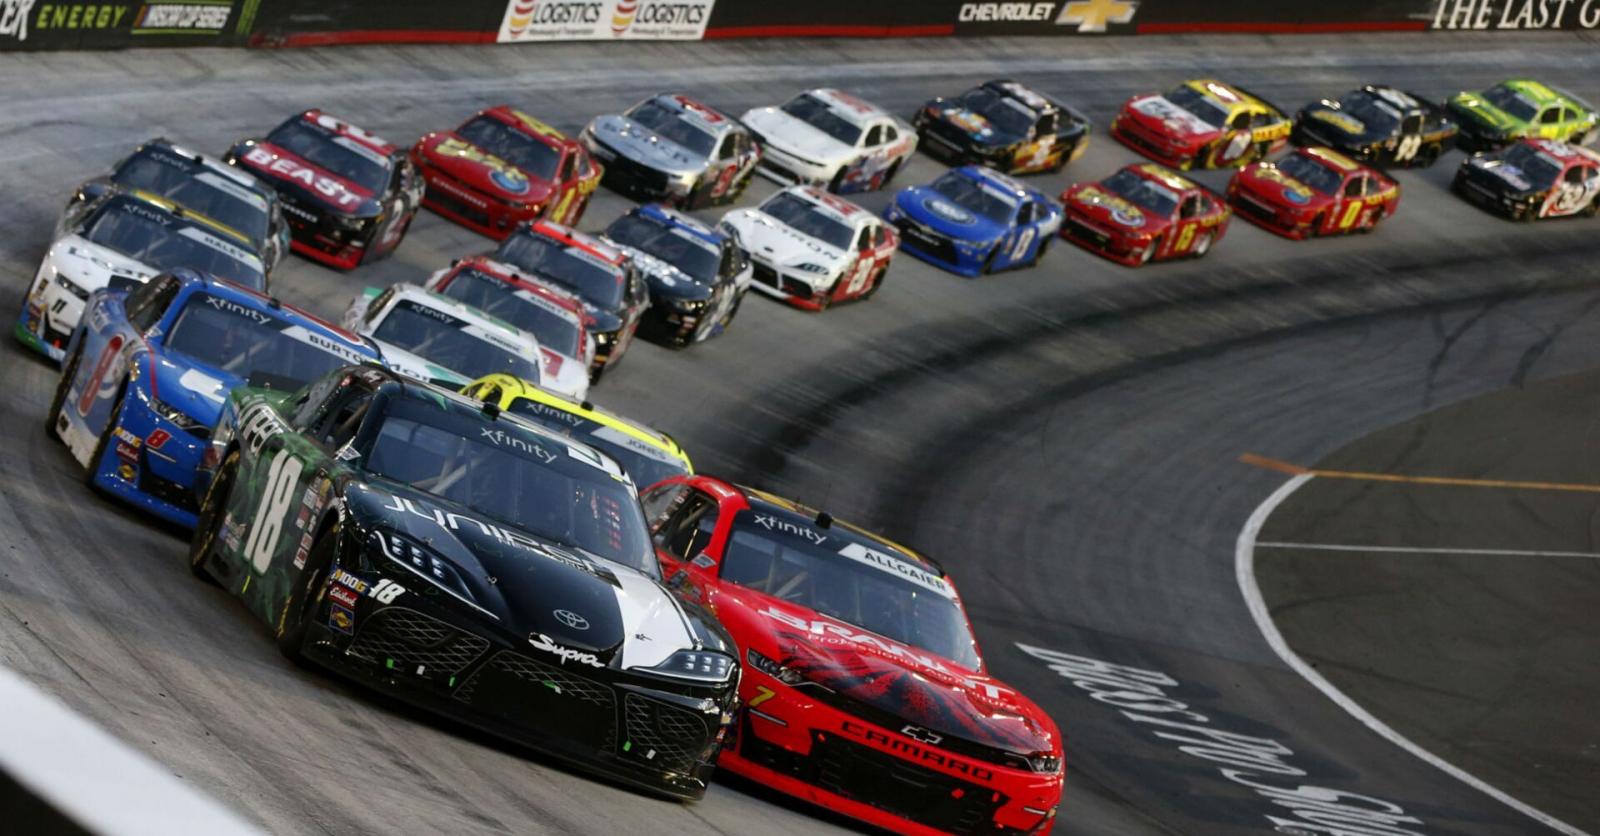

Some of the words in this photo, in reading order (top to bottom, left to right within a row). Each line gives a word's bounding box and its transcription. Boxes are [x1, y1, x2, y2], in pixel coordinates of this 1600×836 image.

[36, 5, 127, 28] ENERGY
[533, 2, 602, 23] LOGISTICS
[635, 3, 706, 23] LOGISTICS
[958, 3, 1056, 22] CHEVROLET
[1431, 0, 1492, 29] THE
[1497, 0, 1574, 29] LAST
[246, 147, 362, 205] BEAST
[122, 202, 173, 226] xfinity
[203, 235, 247, 260] HALEY
[205, 294, 273, 325] xfinity
[410, 303, 455, 324] xfinity
[308, 334, 362, 363] BURTO
[525, 400, 586, 427] xfinity
[145, 427, 172, 450] 8
[480, 426, 559, 464] xfinity
[625, 438, 668, 461] JONES
[243, 447, 304, 577] 18
[753, 514, 829, 545] xfinity
[331, 568, 369, 593] MOOG
[863, 550, 948, 592] ALLGAIER
[367, 578, 407, 605] 18
[528, 632, 606, 667] Supra
[749, 685, 776, 706] 7
[841, 720, 995, 782] CAMARO
